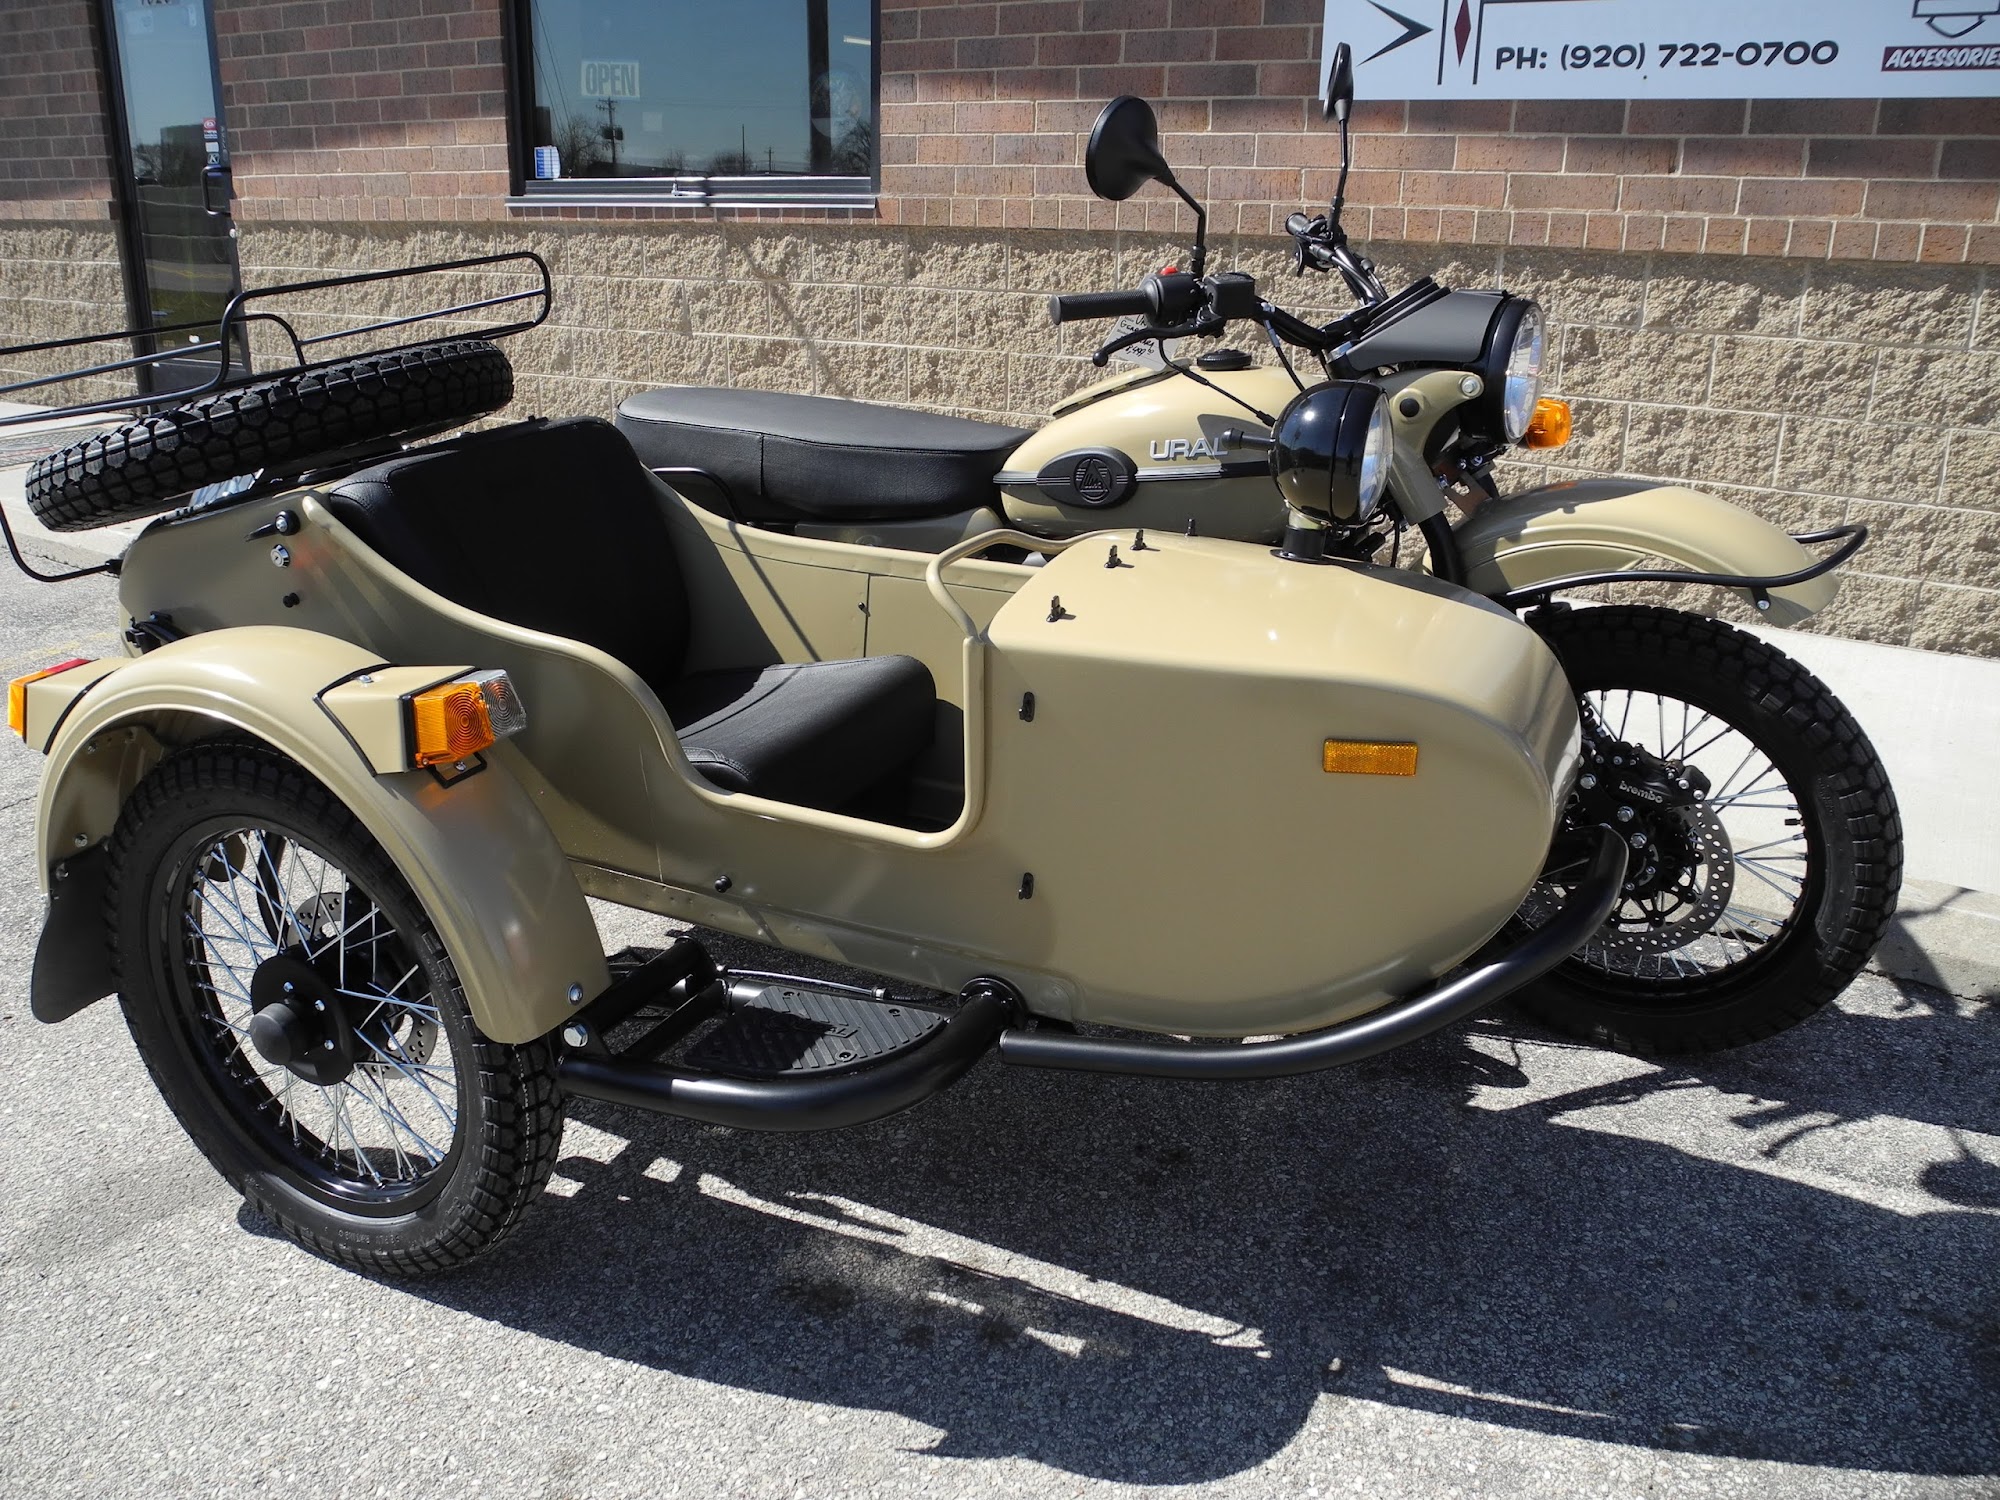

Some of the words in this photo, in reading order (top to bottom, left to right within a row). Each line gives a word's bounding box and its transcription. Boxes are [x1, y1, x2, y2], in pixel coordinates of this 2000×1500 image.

[1496, 46, 1548, 70] PH:
[1561, 42, 1645, 71] (920)
[1658, 40, 1839, 68] 722-0700
[1885, 47, 2000, 68] ACCESSORIE
[585, 62, 636, 97] OPEN
[1149, 437, 1229, 461] URAL
[1619, 780, 1663, 804] brembo
